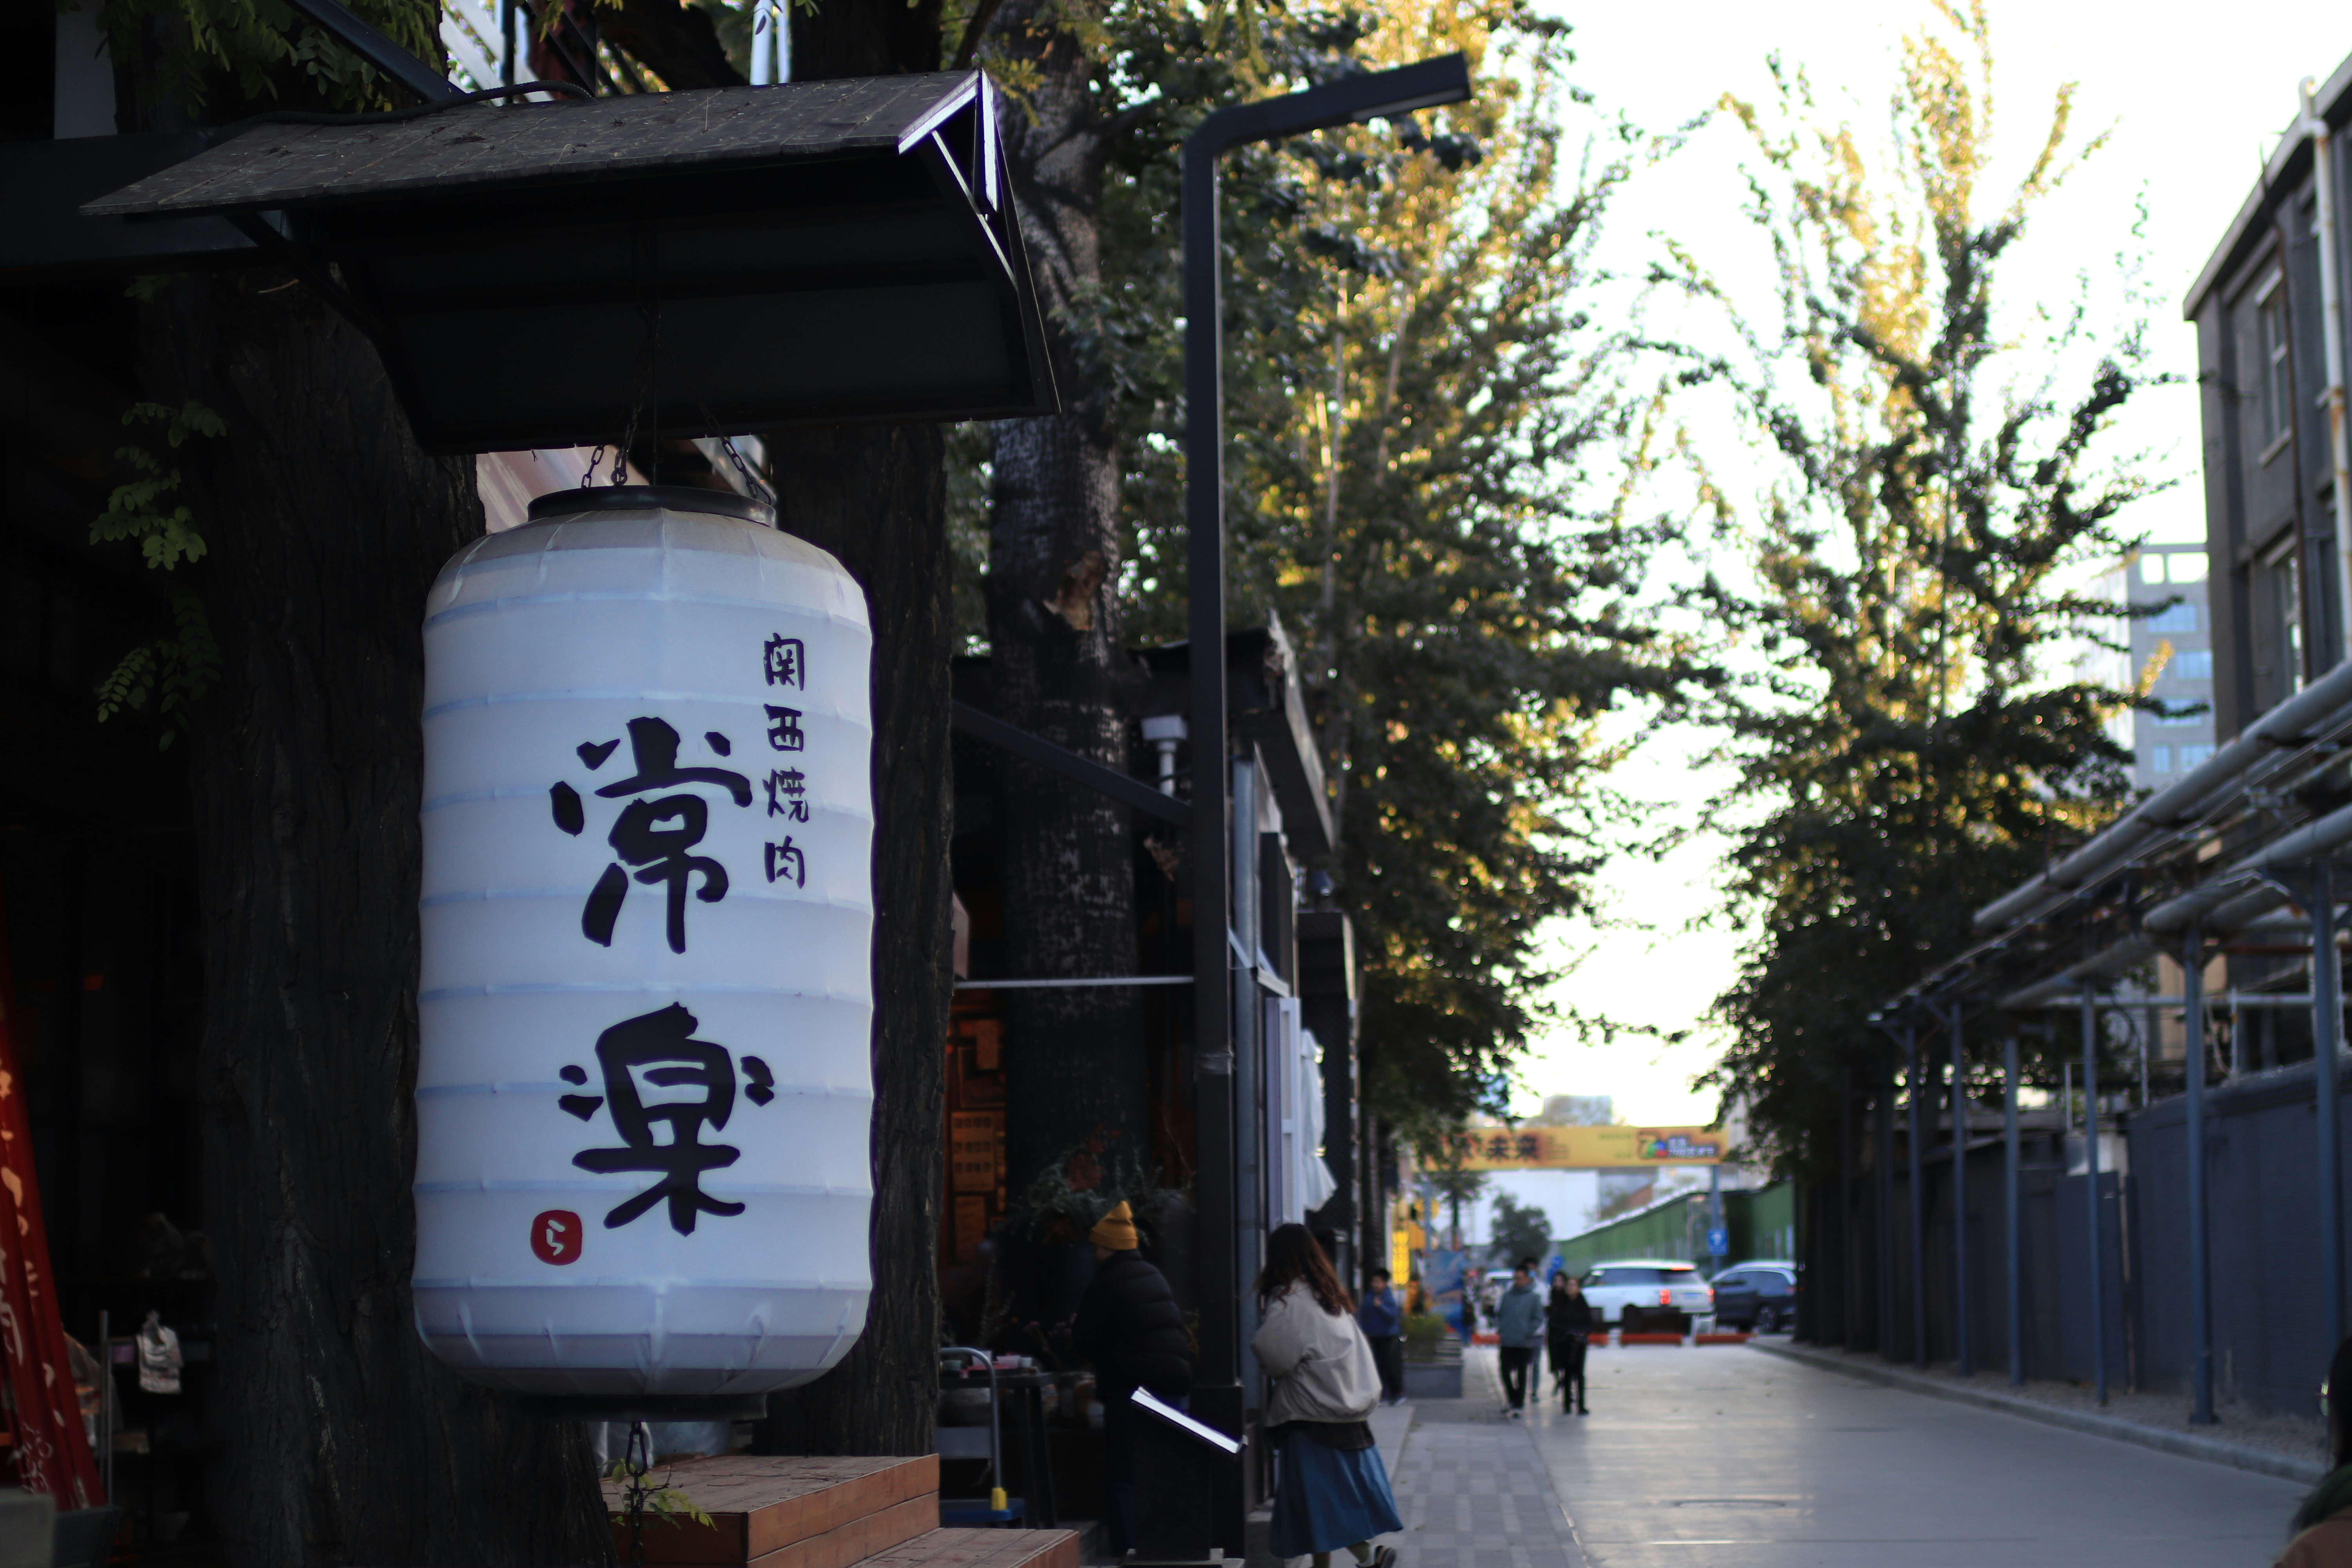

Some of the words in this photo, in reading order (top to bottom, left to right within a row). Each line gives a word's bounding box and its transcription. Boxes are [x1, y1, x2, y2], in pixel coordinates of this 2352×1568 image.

[762, 632, 809, 889] 関西焼肉
[546, 1219, 566, 1256] ら
